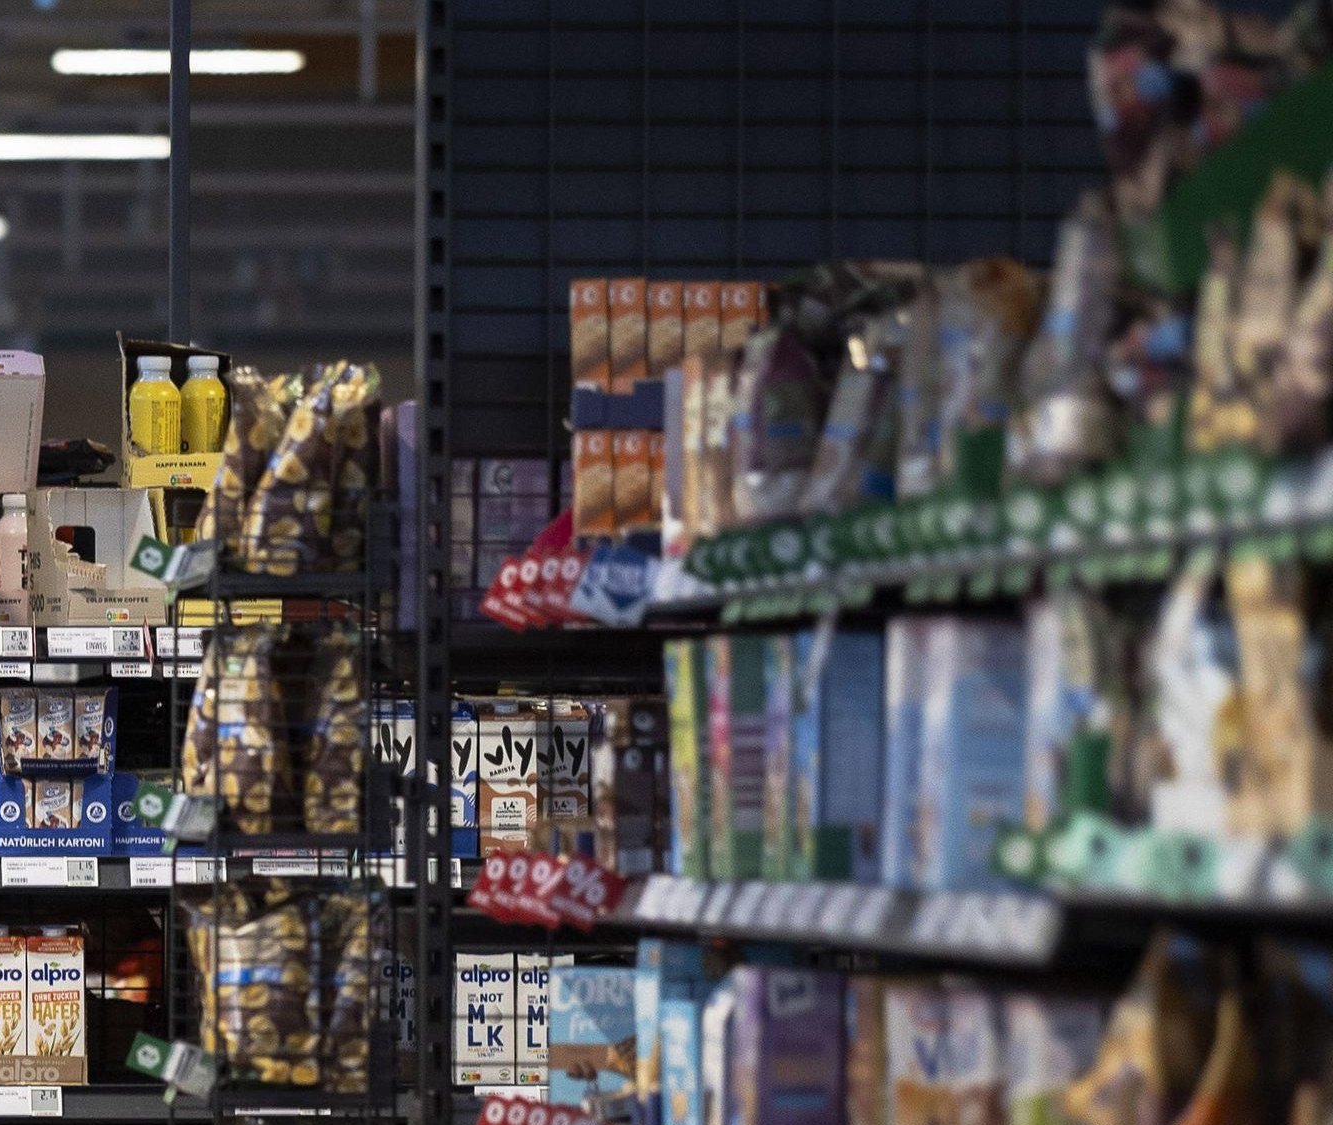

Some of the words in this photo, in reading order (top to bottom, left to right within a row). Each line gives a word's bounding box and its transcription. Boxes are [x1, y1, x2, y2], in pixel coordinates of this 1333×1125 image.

[489, 765, 516, 778] BARISTA
[0, 837, 55, 848] NATÜRLICH
[58, 837, 105, 848] KARTON!
[115, 836, 161, 845] HAUPTSACHE
[31, 962, 81, 986] alpro
[460, 964, 511, 987] alpro
[479, 993, 504, 1003] NOT
[32, 1001, 80, 1021] HAFER
